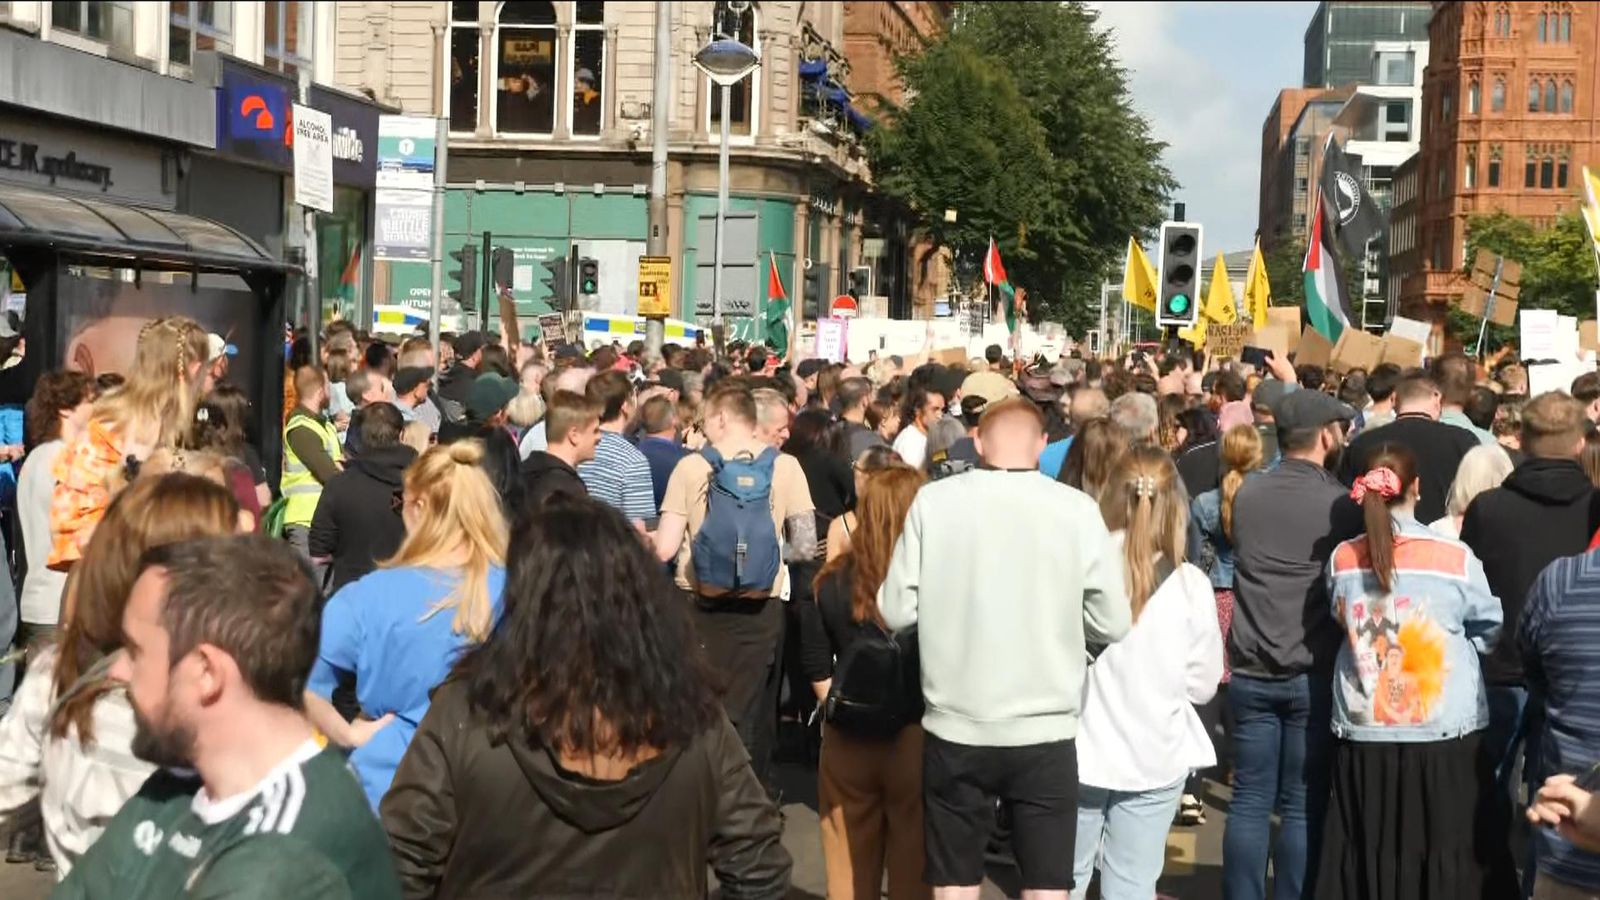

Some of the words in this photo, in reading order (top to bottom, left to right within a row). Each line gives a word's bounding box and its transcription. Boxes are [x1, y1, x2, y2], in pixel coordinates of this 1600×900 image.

[299, 119, 327, 136] ALCOHOL
[297, 128, 311, 138] FREE
[312, 132, 329, 143] AREA
[401, 299, 432, 308] AUTUM
[1208, 325, 1248, 337] RACISM
